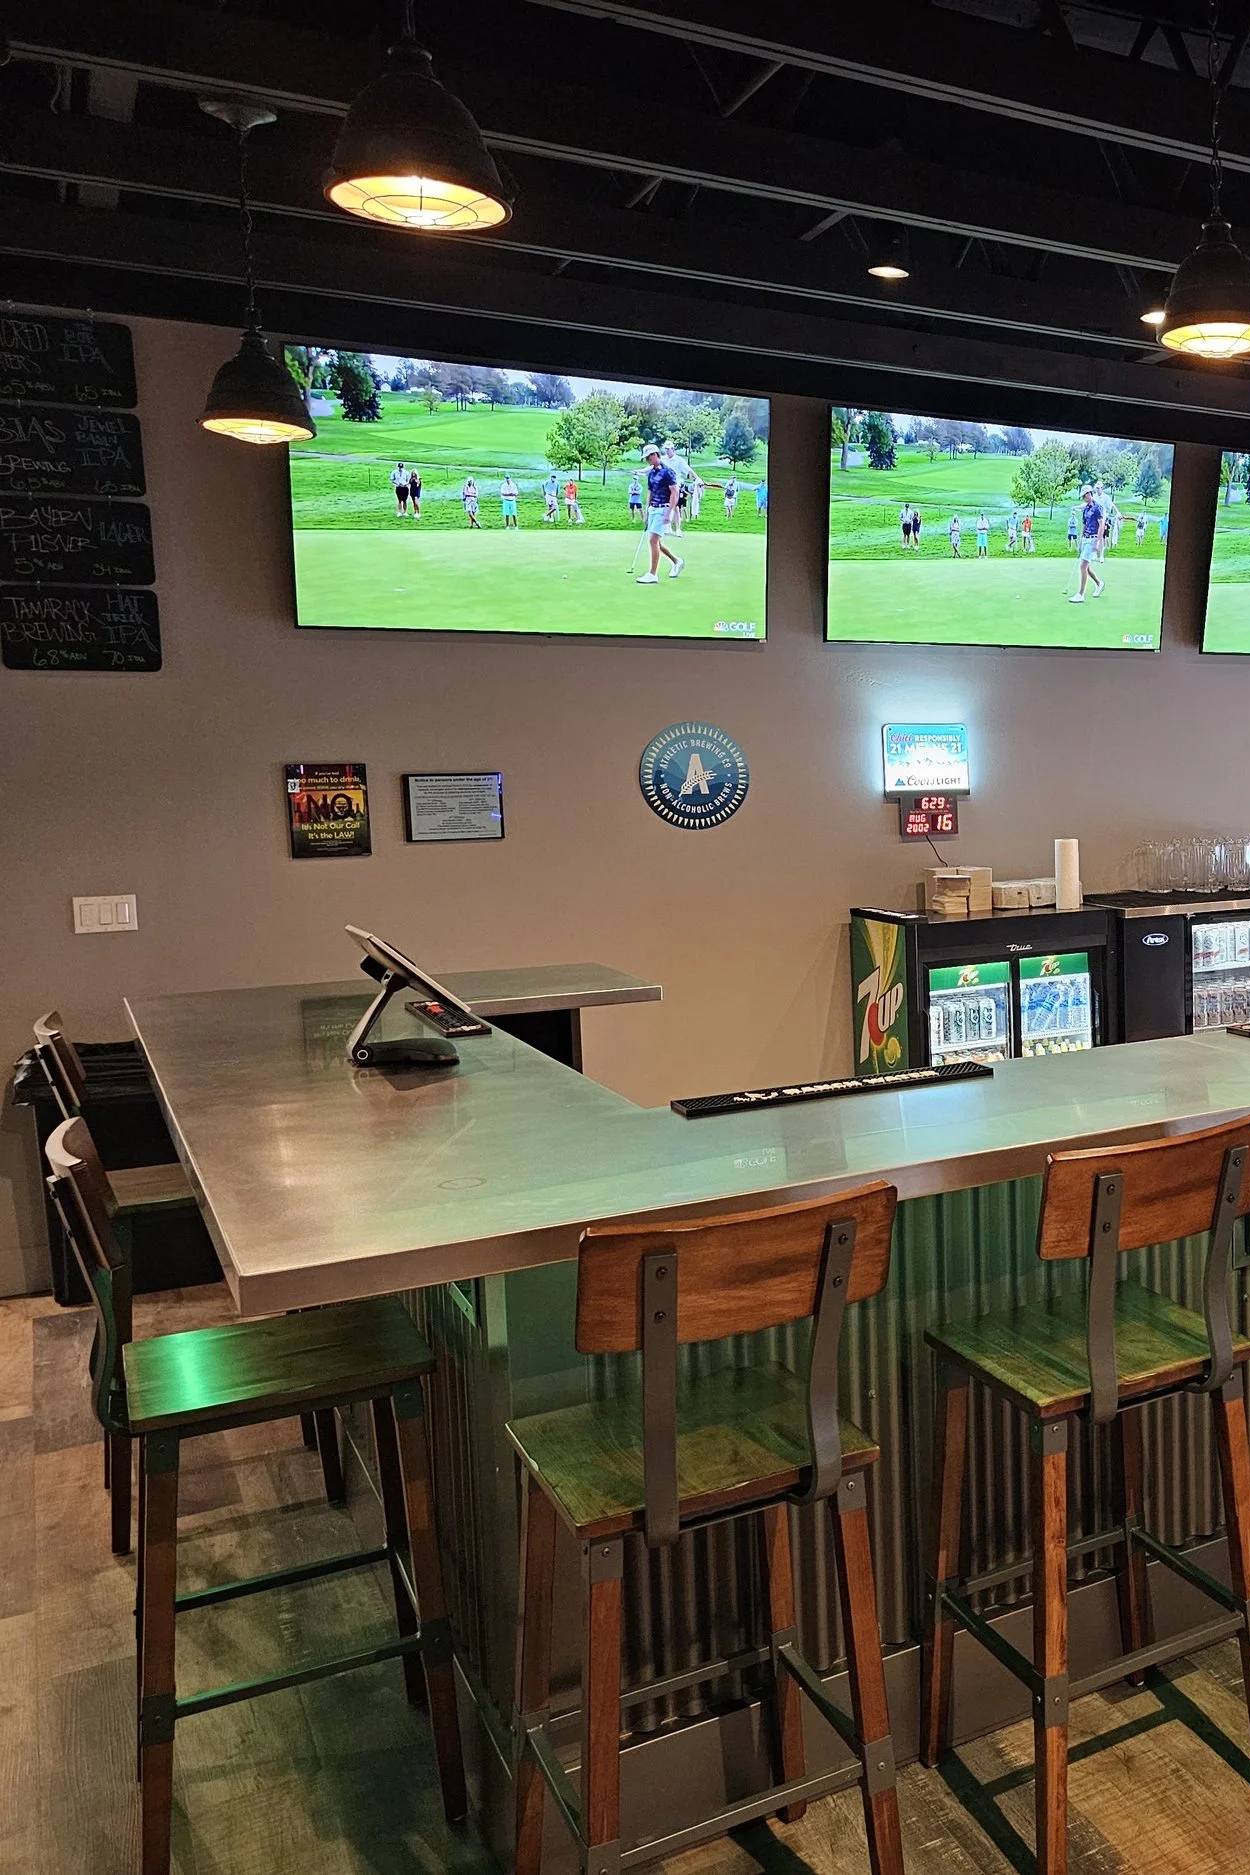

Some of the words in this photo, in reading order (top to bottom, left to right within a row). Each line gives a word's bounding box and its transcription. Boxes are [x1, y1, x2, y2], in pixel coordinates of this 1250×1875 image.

[729, 622, 757, 632] GOLF
[659, 741, 688, 769] ATHLETIC
[690, 740, 726, 759] BREWING
[890, 743, 902, 754] 21
[951, 742, 963, 753] 21
[936, 777, 962, 786] LIGHT
[660, 782, 714, 814] NON-ALCOHOLIC
[714, 782, 733, 807] BREWS
[908, 814, 926, 823] AUG
[936, 814, 953, 830] 16
[856, 966, 904, 1064] 7UP
